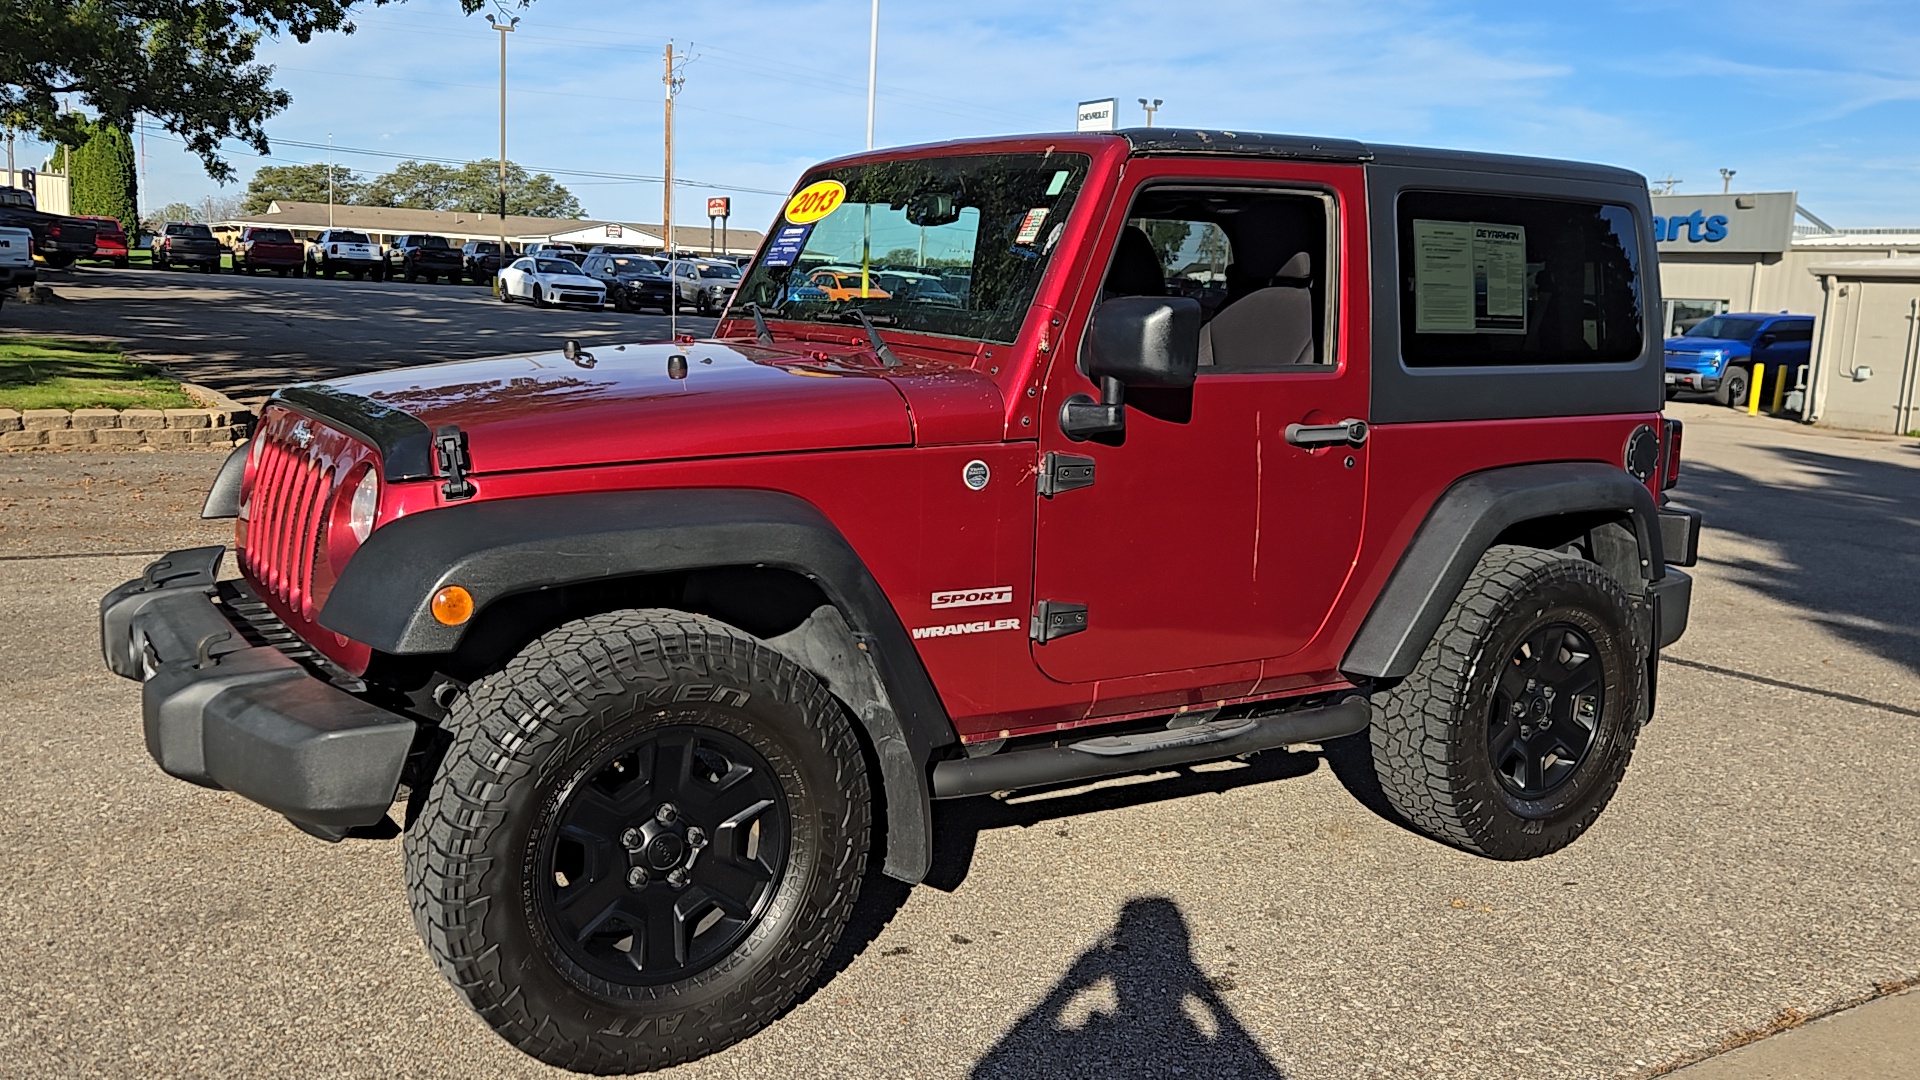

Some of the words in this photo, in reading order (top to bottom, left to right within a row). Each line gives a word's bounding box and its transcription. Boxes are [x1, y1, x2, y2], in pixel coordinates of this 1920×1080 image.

[1080, 110, 1109, 121] CHEVROLET
[789, 190, 840, 215] 2013
[1476, 229, 1520, 240] DEYARMAN
[937, 591, 1007, 604] SPORT
[912, 618, 1021, 639] WRANGLER
[534, 683, 751, 790] FALKEN
